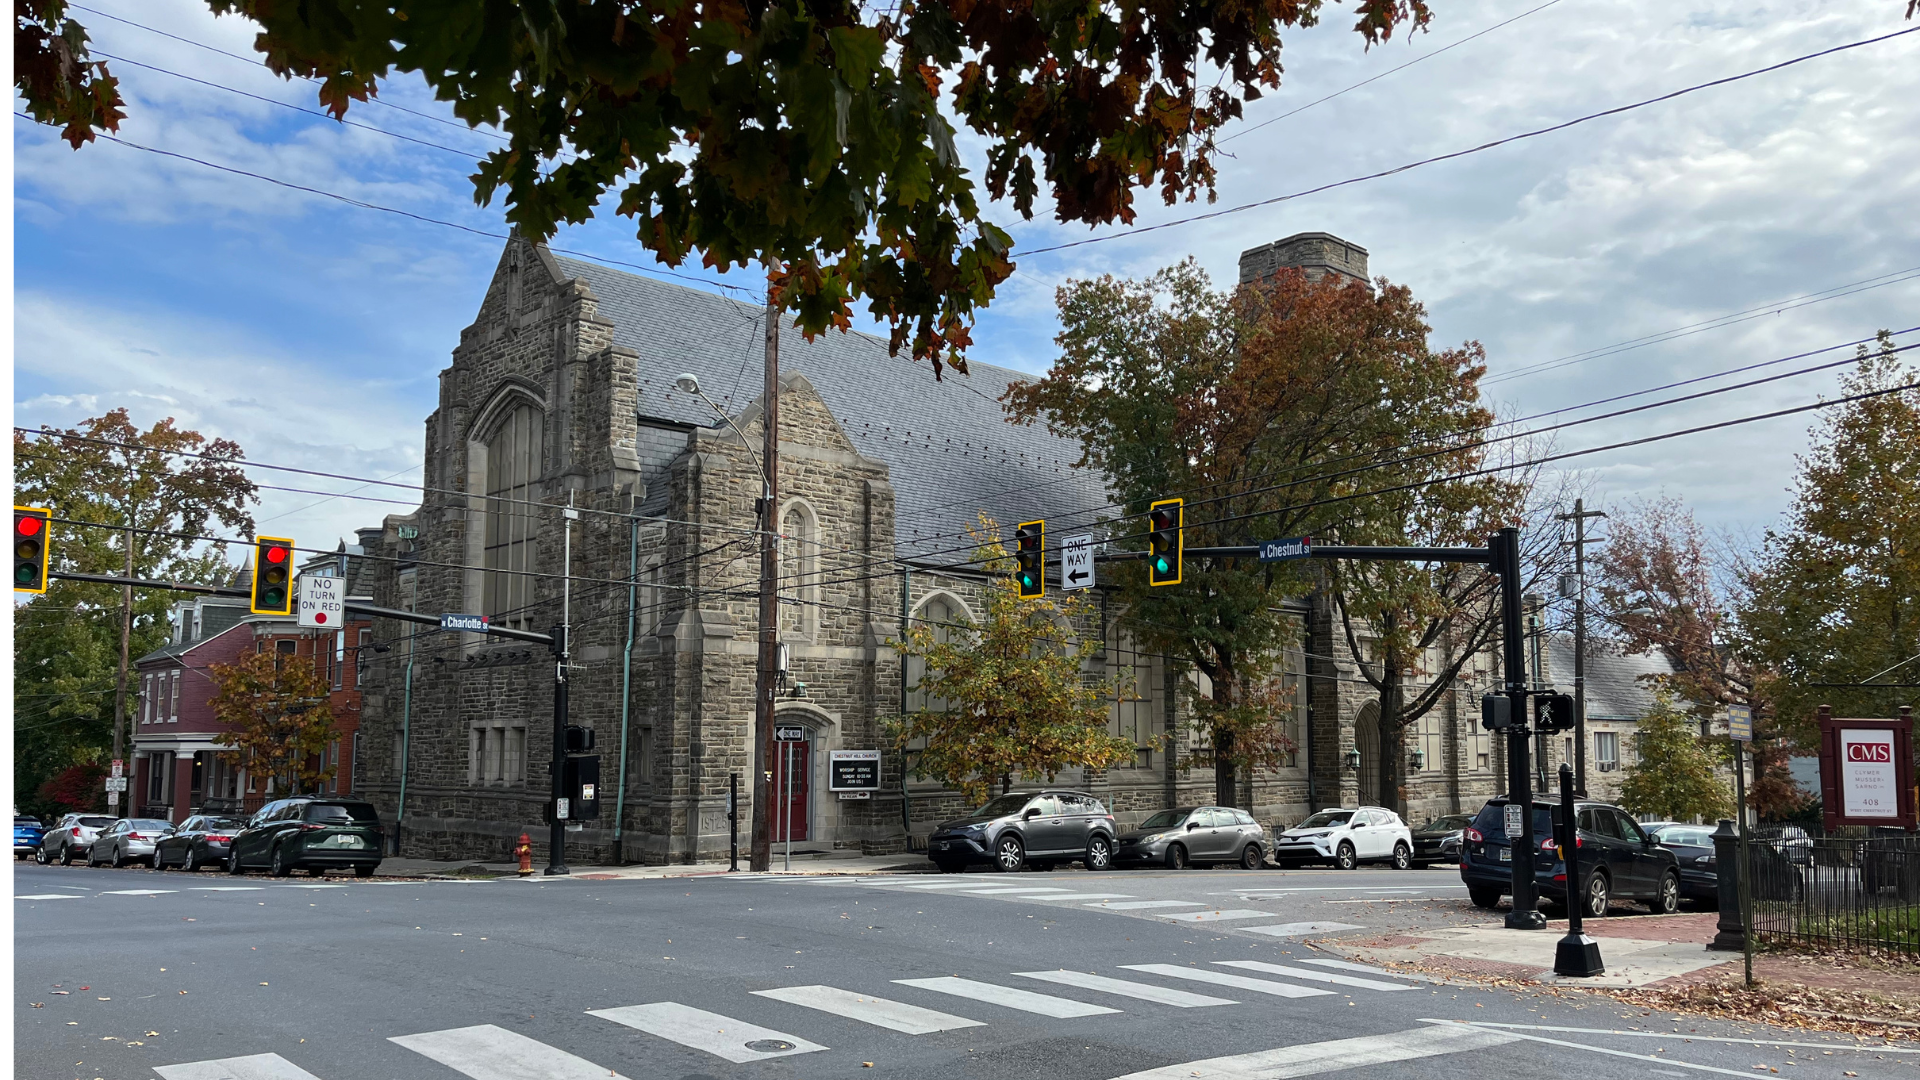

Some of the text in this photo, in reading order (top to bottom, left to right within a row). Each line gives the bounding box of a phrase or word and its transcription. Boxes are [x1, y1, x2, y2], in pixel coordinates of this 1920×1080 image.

[1068, 539, 1087, 552] ONE
[1267, 541, 1302, 558] Chestnut
[1067, 553, 1087, 566] WAY
[314, 579, 332, 589] NO
[310, 591, 335, 600] TURN
[302, 601, 340, 611] ON RED
[447, 616, 481, 629] Charlotte
[1849, 744, 1889, 761] CMS
[1862, 798, 1879, 806] 408
